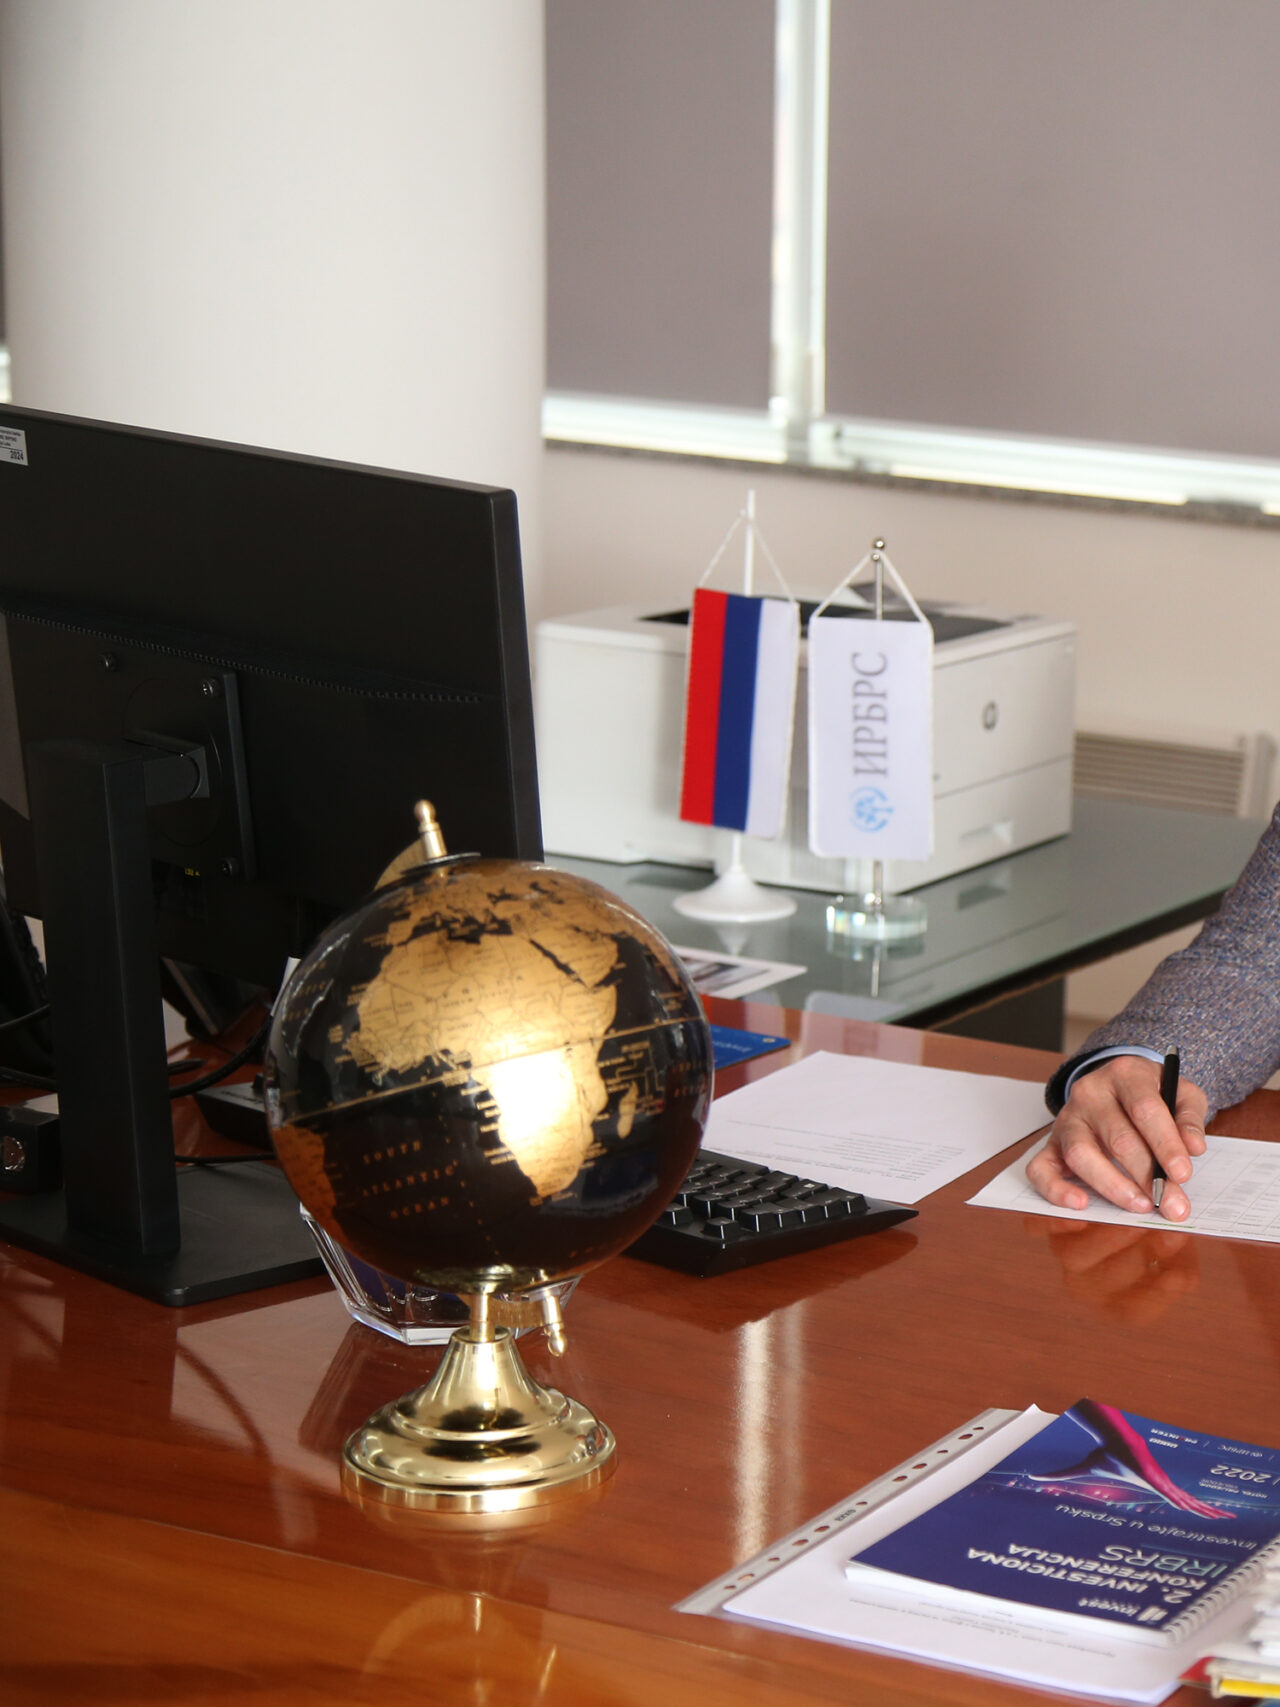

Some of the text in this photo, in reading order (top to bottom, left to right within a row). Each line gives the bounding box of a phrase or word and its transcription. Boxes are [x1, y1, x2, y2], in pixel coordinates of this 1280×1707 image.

[850, 651, 888, 778] ИРБРС
[1210, 1464, 1273, 1483] 2022
[1055, 1504, 1259, 1551] Investirajte u Srpsku
[967, 1548, 1193, 1604] 2. INVESTICIONA
[1008, 1543, 1208, 1591] KONFERENCIJA
[1098, 1544, 1229, 1579] IRBRS
